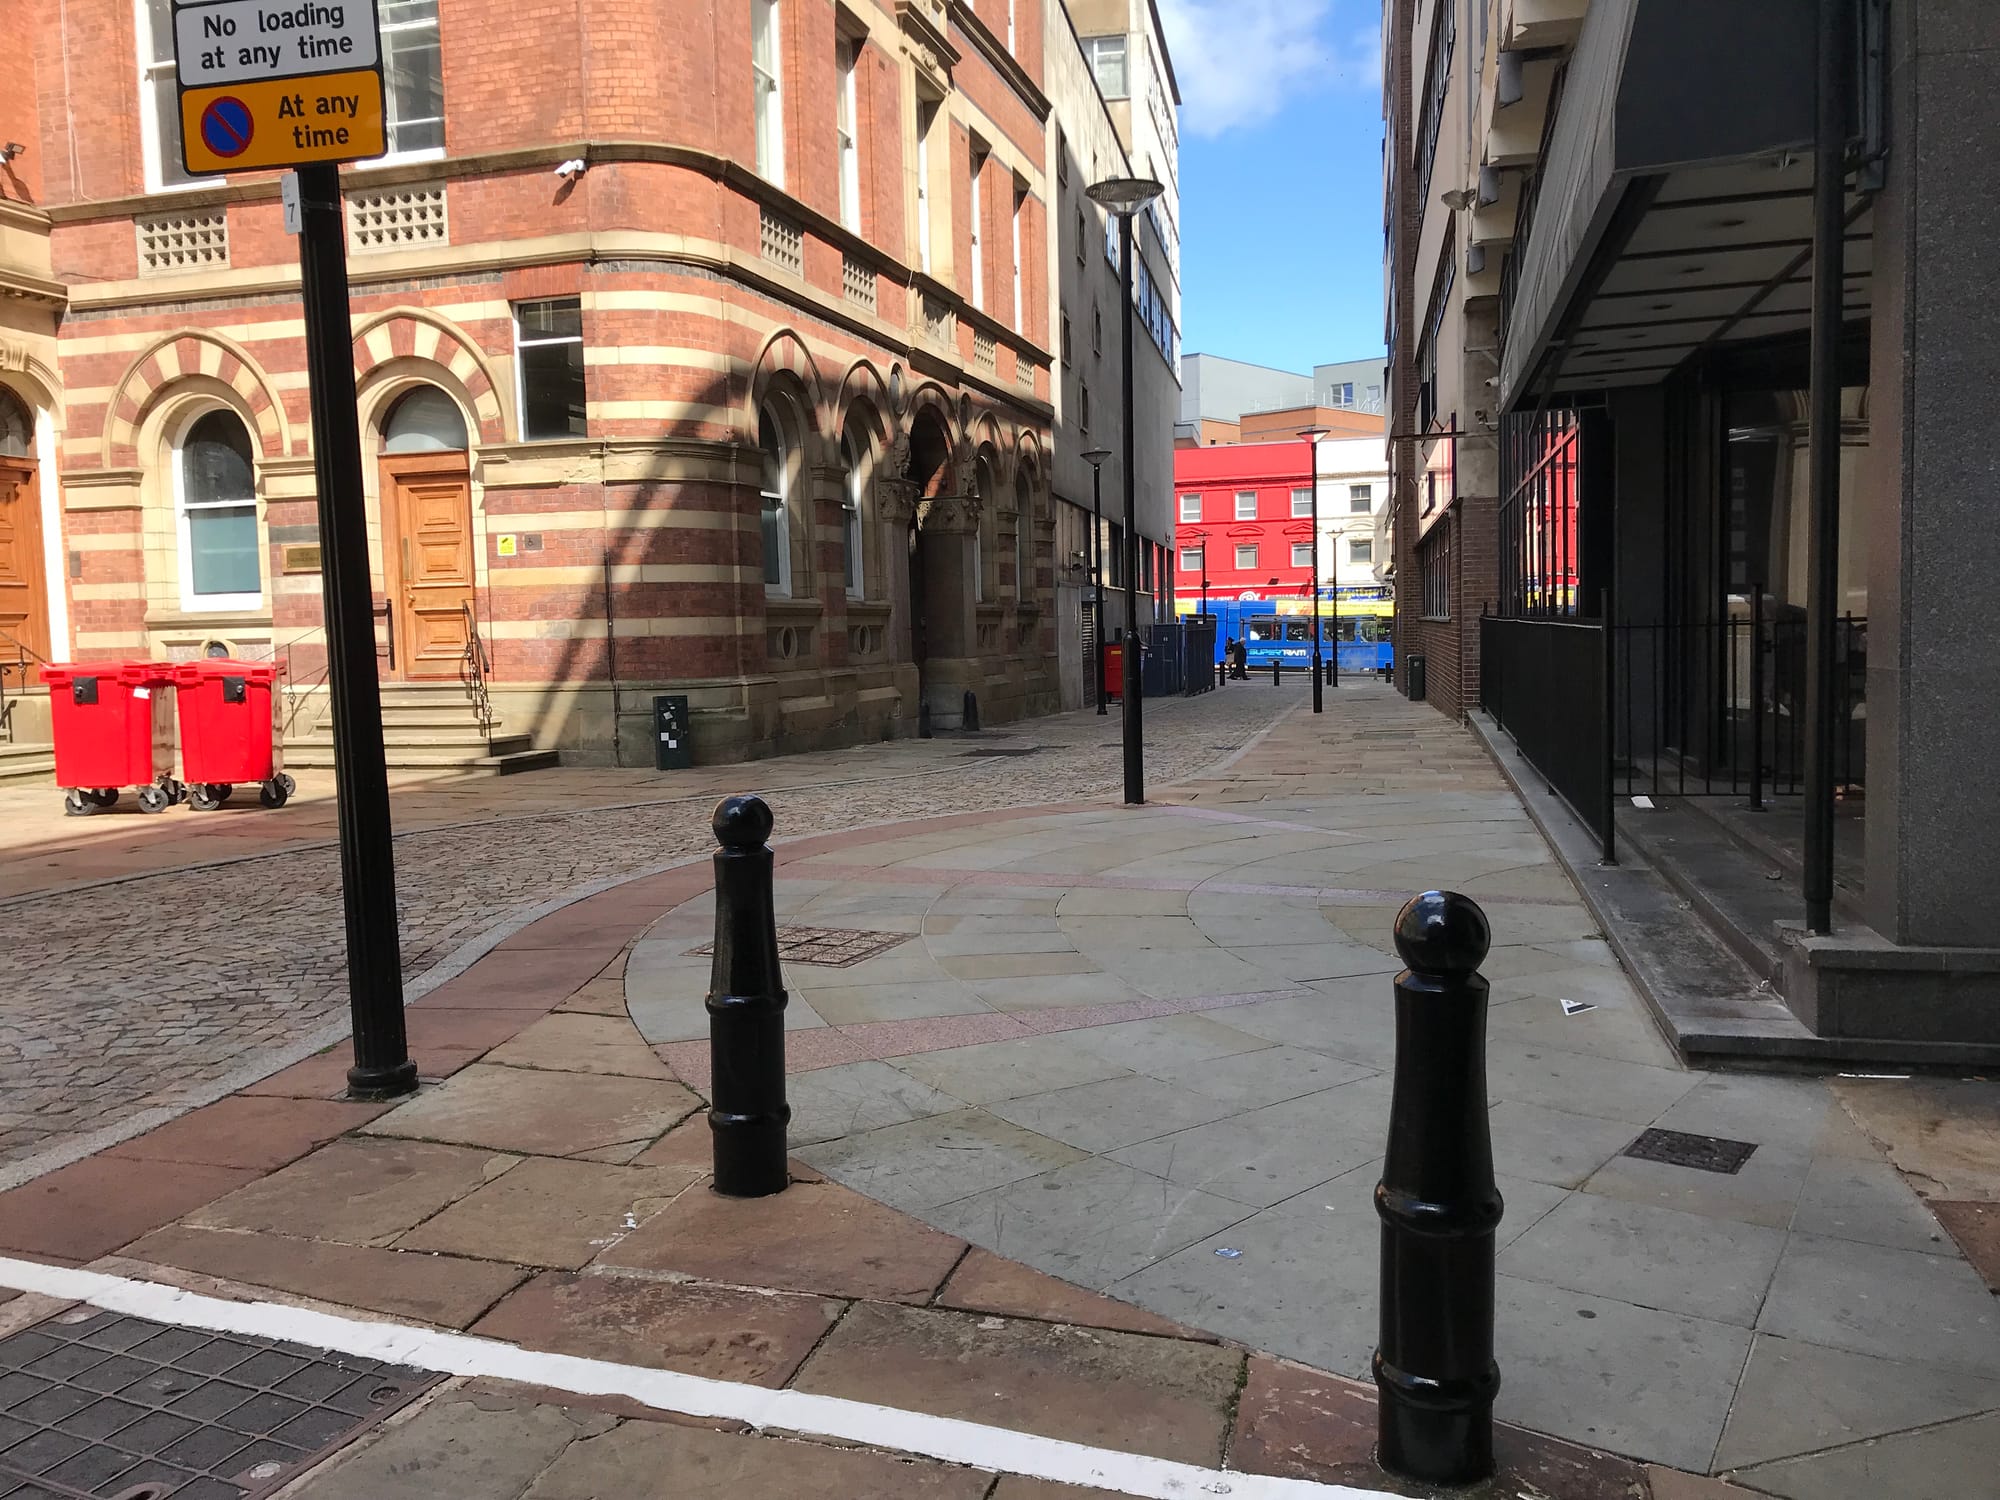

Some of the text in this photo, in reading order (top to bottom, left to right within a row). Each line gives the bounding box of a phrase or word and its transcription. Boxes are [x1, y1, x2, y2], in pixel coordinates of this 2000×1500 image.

[203, 3, 344, 38] No loading
[201, 35, 353, 69] at any time
[278, 94, 359, 119] At any
[292, 126, 349, 149] time
[287, 202, 296, 223] 7
